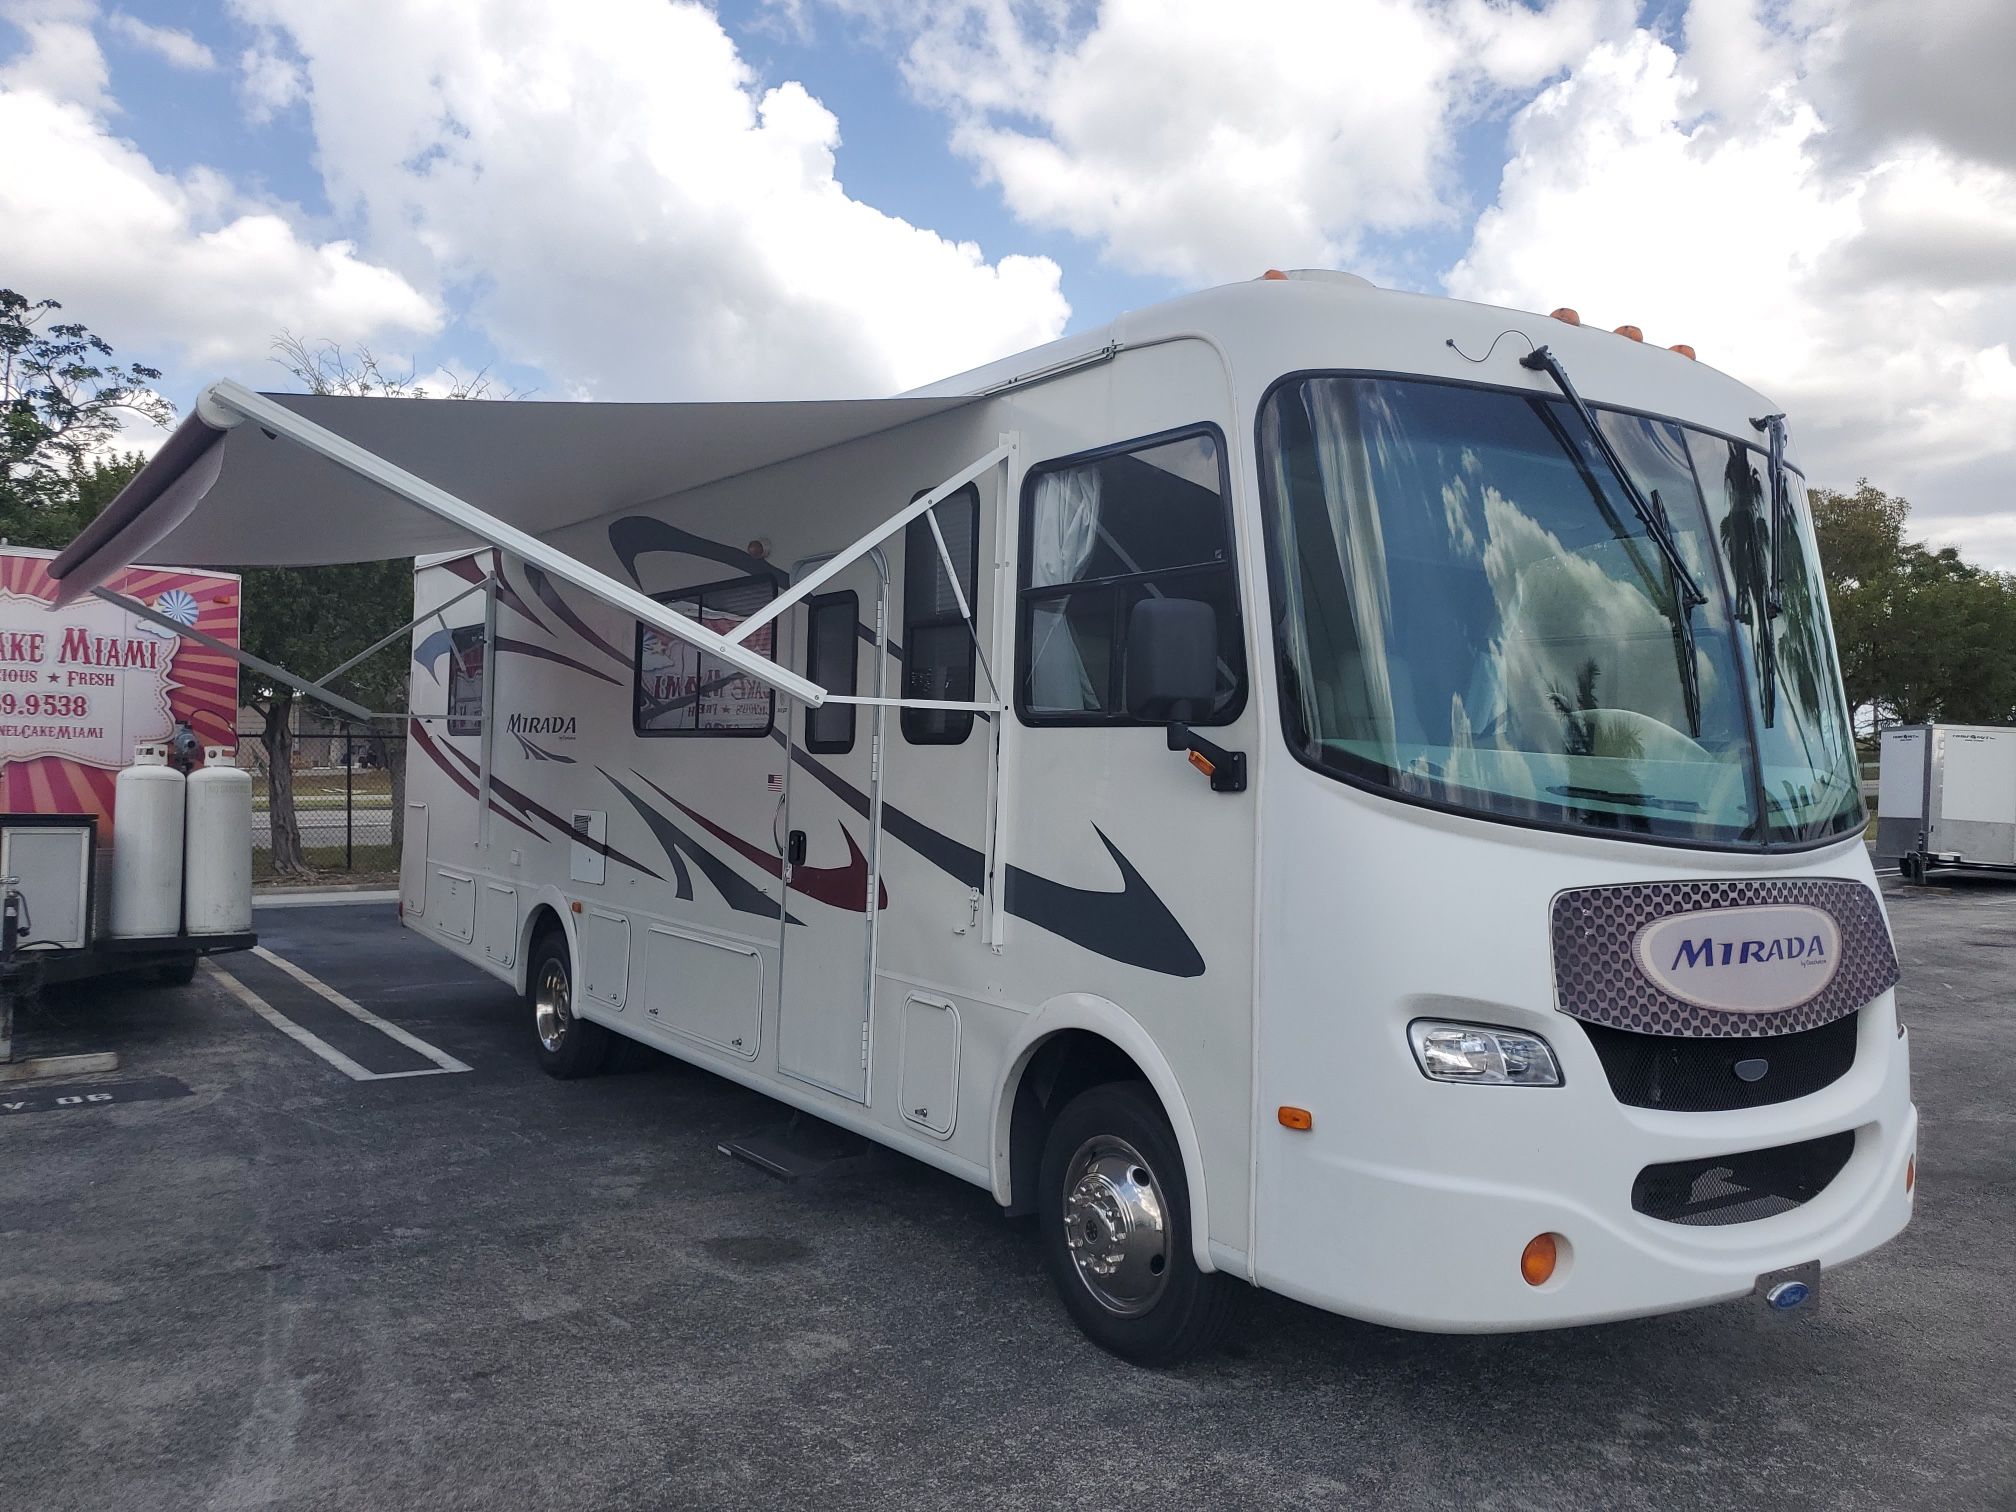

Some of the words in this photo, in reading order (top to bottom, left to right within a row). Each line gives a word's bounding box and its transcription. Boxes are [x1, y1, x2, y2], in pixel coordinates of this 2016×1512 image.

[58, 628, 158, 669] MIAMI
[0, 669, 38, 683] IOUS
[67, 671, 115, 687] FRESH
[0, 693, 87, 716] 9.9538
[506, 713, 576, 734] MIRADA
[1671, 935, 1824, 971] MIRADA
